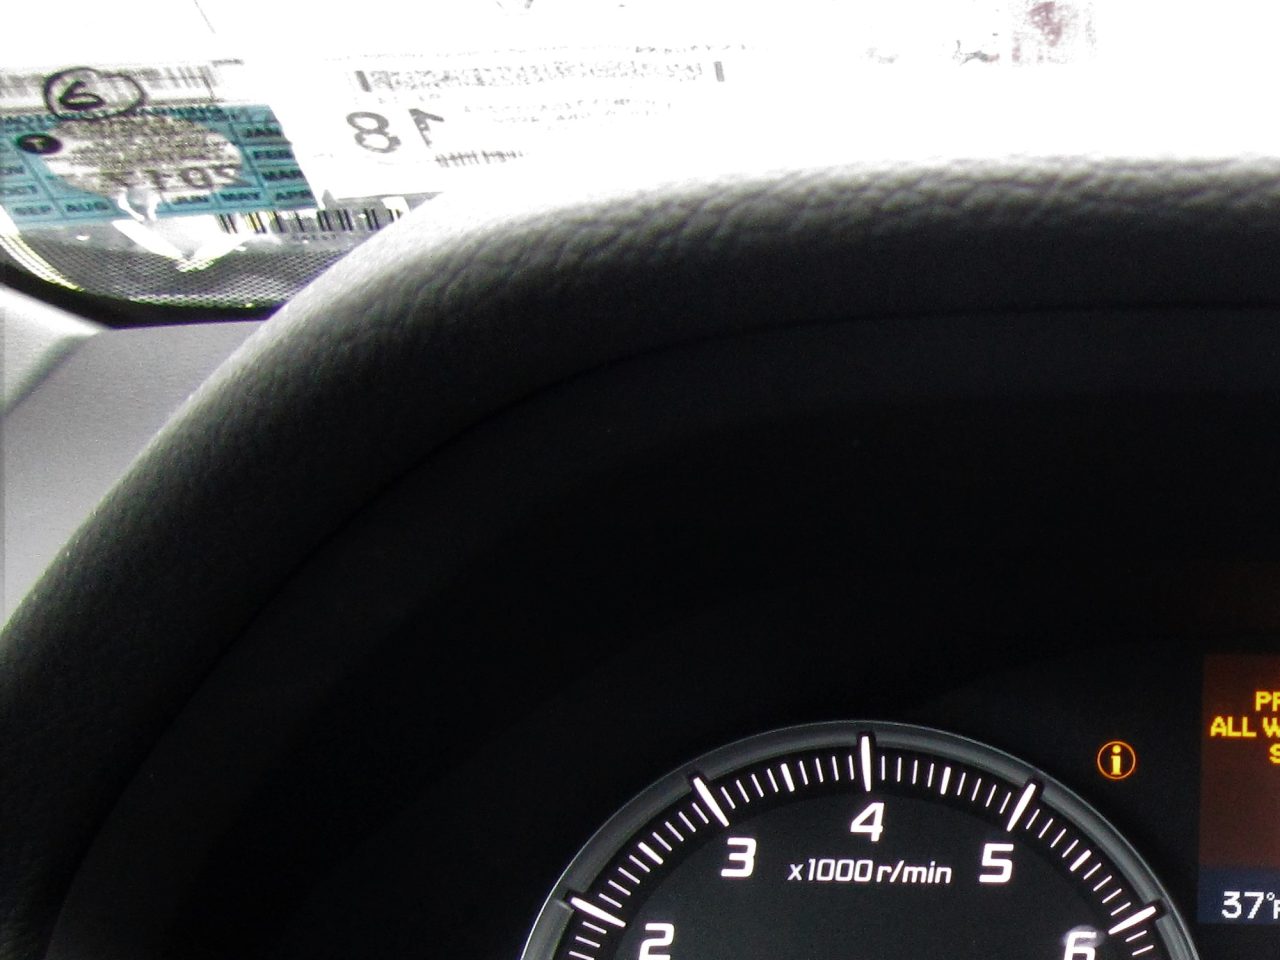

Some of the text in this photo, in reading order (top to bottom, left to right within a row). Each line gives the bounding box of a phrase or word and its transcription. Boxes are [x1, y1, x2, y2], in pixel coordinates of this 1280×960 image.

[1210, 715, 1257, 738] ALL
[850, 802, 885, 842] 4
[720, 836, 757, 878] 3
[876, 859, 952, 884] r/min
[978, 842, 1014, 884] 5
